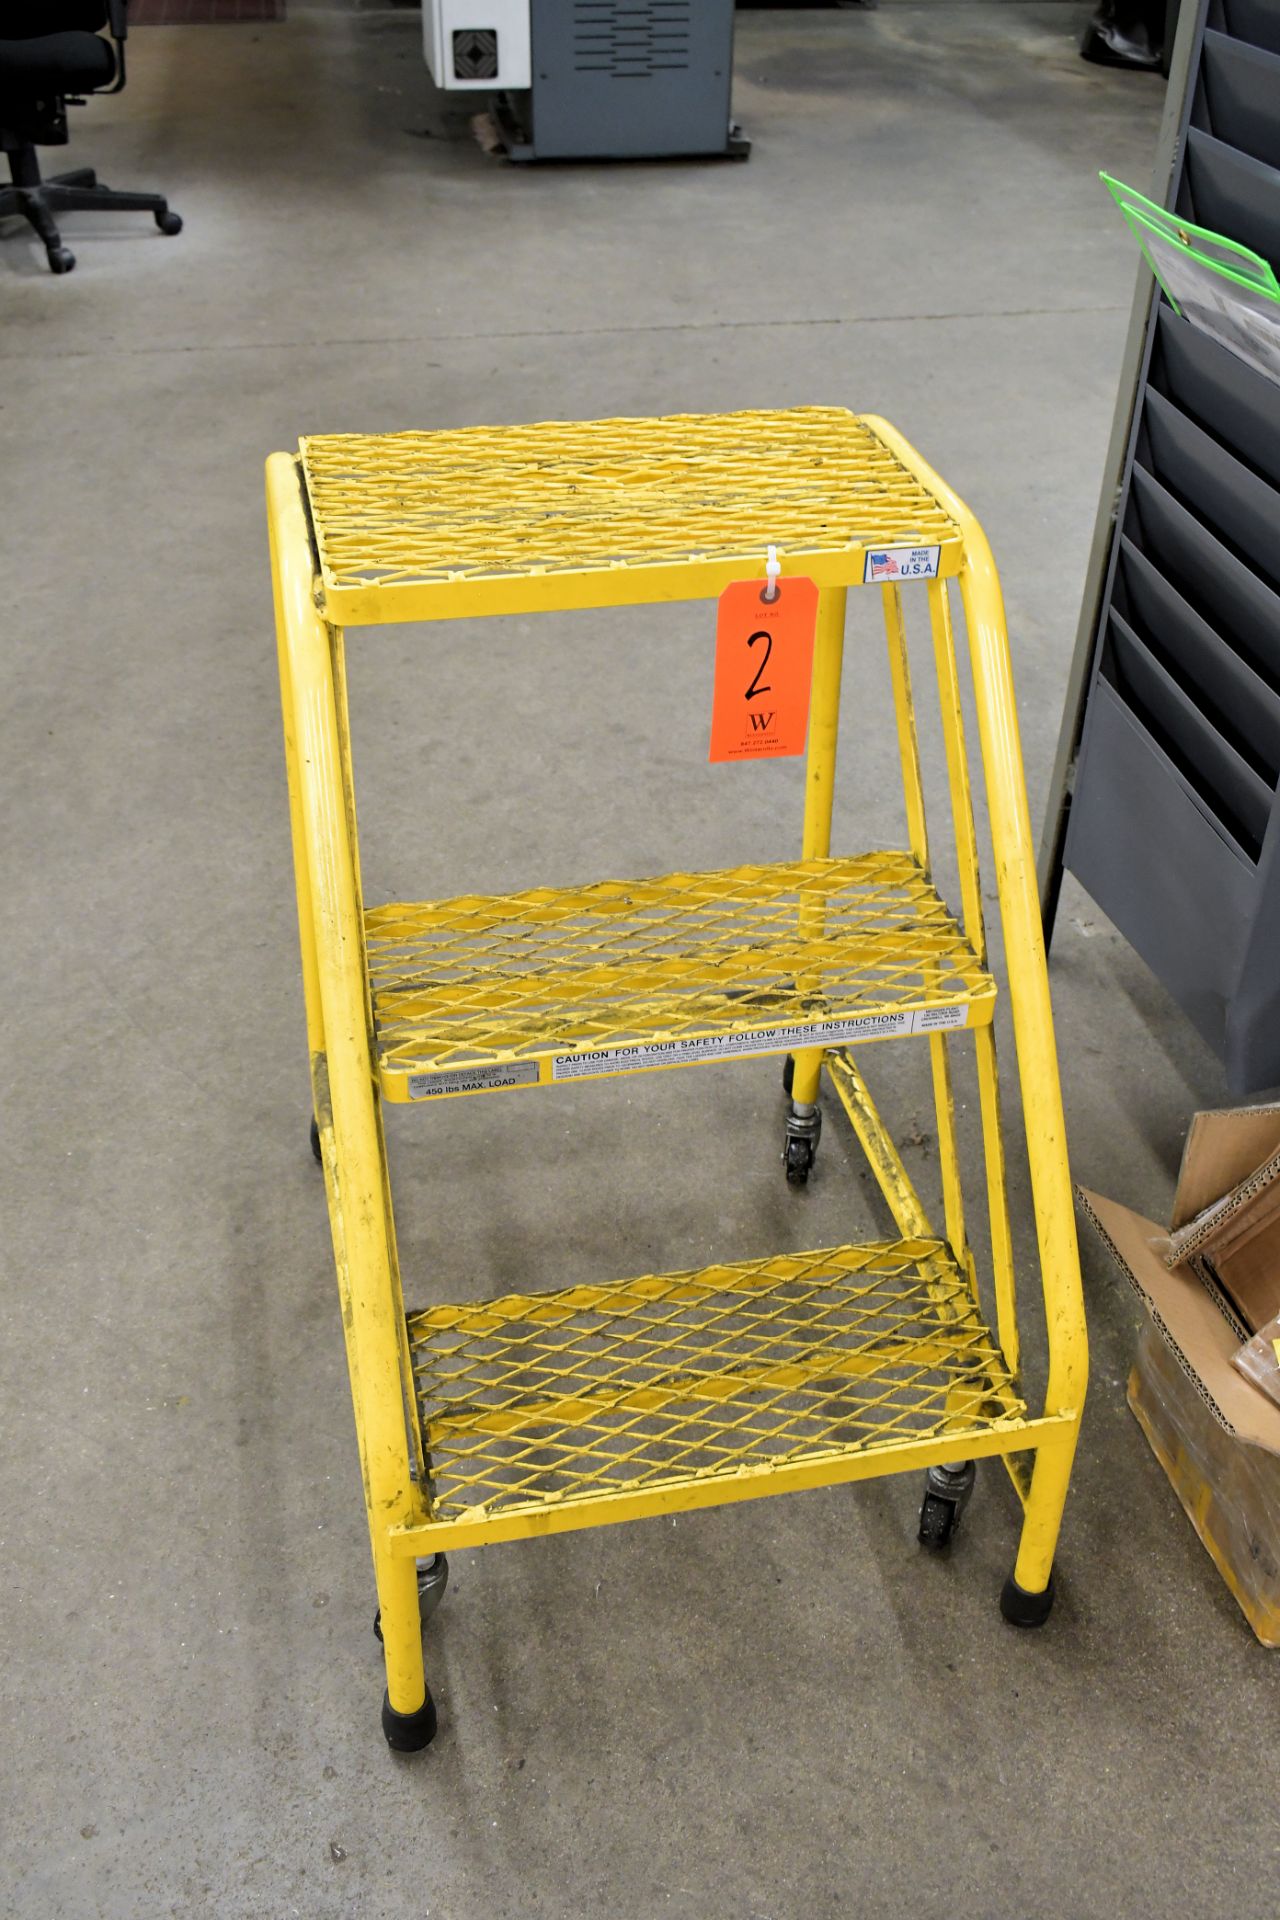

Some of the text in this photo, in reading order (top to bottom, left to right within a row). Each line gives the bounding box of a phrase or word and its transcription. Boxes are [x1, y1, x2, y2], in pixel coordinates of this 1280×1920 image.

[901, 563, 936, 576] U.S.A.
[744, 631, 773, 701] 2
[748, 711, 776, 731] W
[555, 1013, 905, 1064] CAUTION FOR YOUR SAFETY FOLLOW THESE INSTRUCTIONS
[425, 1077, 516, 1096] 450 lbs MAX. LOAD
